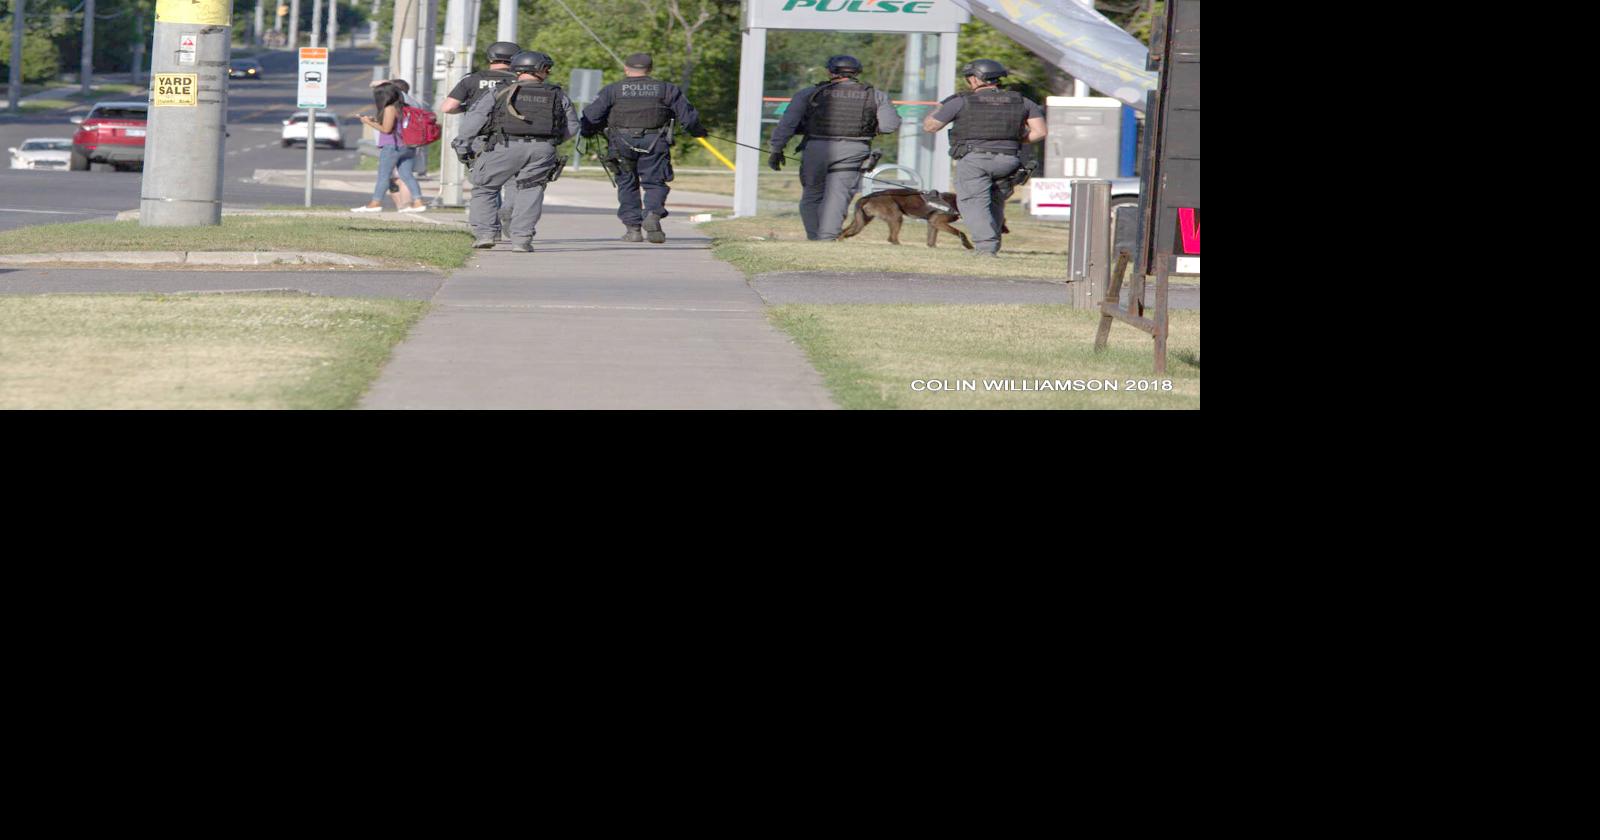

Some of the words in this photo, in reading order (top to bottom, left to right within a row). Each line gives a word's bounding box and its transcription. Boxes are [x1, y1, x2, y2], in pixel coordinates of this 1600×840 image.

[782, 0, 935, 14] PULSE
[159, 77, 192, 86] YARD
[159, 86, 191, 95] SALE
[822, 89, 866, 99] POLICE
[517, 95, 550, 104] POLICE
